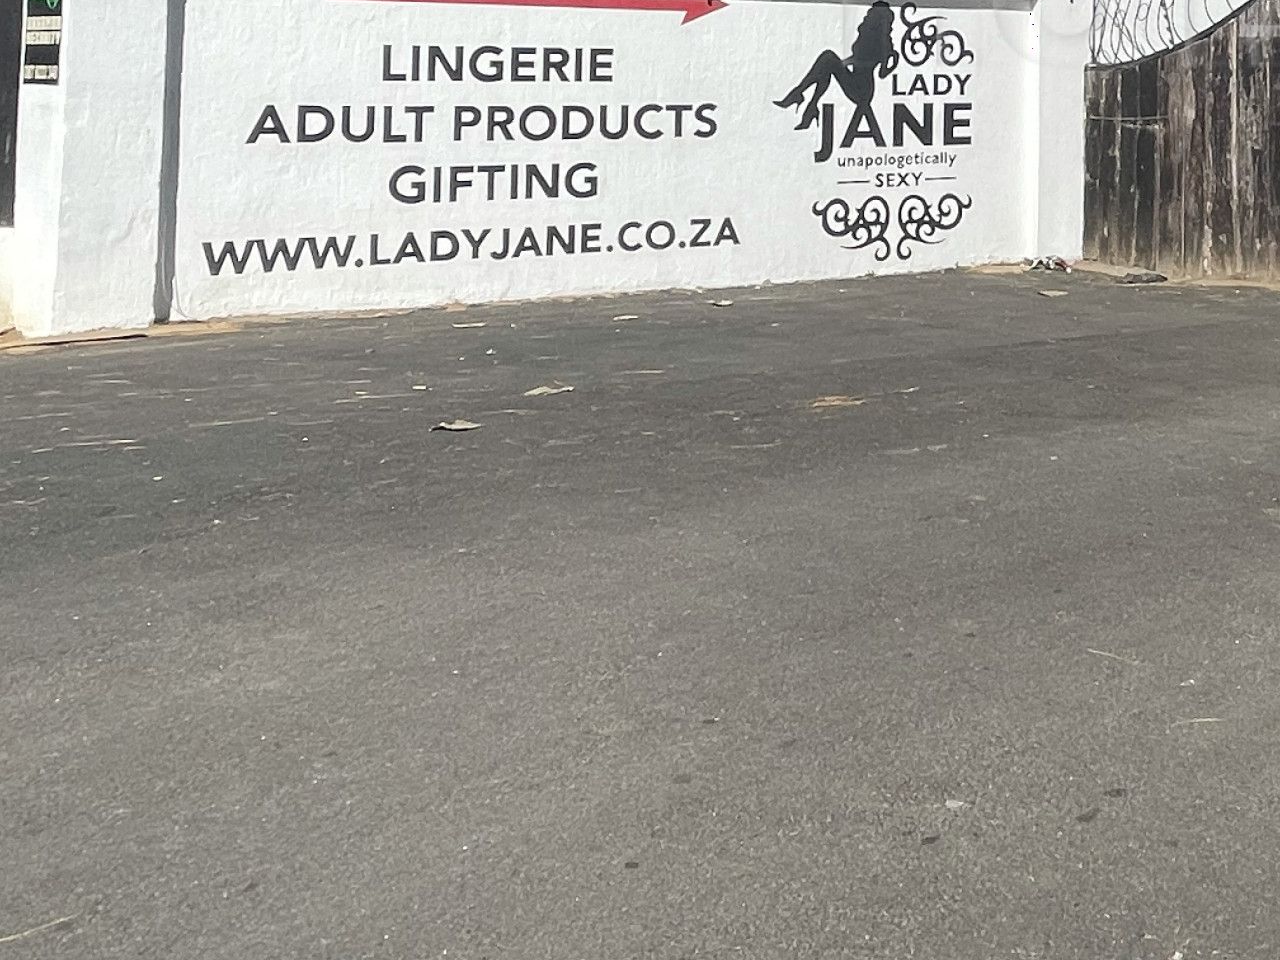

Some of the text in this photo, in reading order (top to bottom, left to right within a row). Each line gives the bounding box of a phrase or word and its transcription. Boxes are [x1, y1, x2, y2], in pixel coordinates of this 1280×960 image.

[382, 44, 615, 83] LINGERIE
[891, 73, 972, 97] LADY
[245, 103, 718, 145] ADULT PRODUCTS
[814, 102, 973, 163] JANE
[837, 151, 957, 169] unapologetically
[874, 171, 923, 188] SEXY
[388, 162, 599, 205] GIFTING
[202, 217, 741, 277] WWW.LADYJANE.CO.ZA
